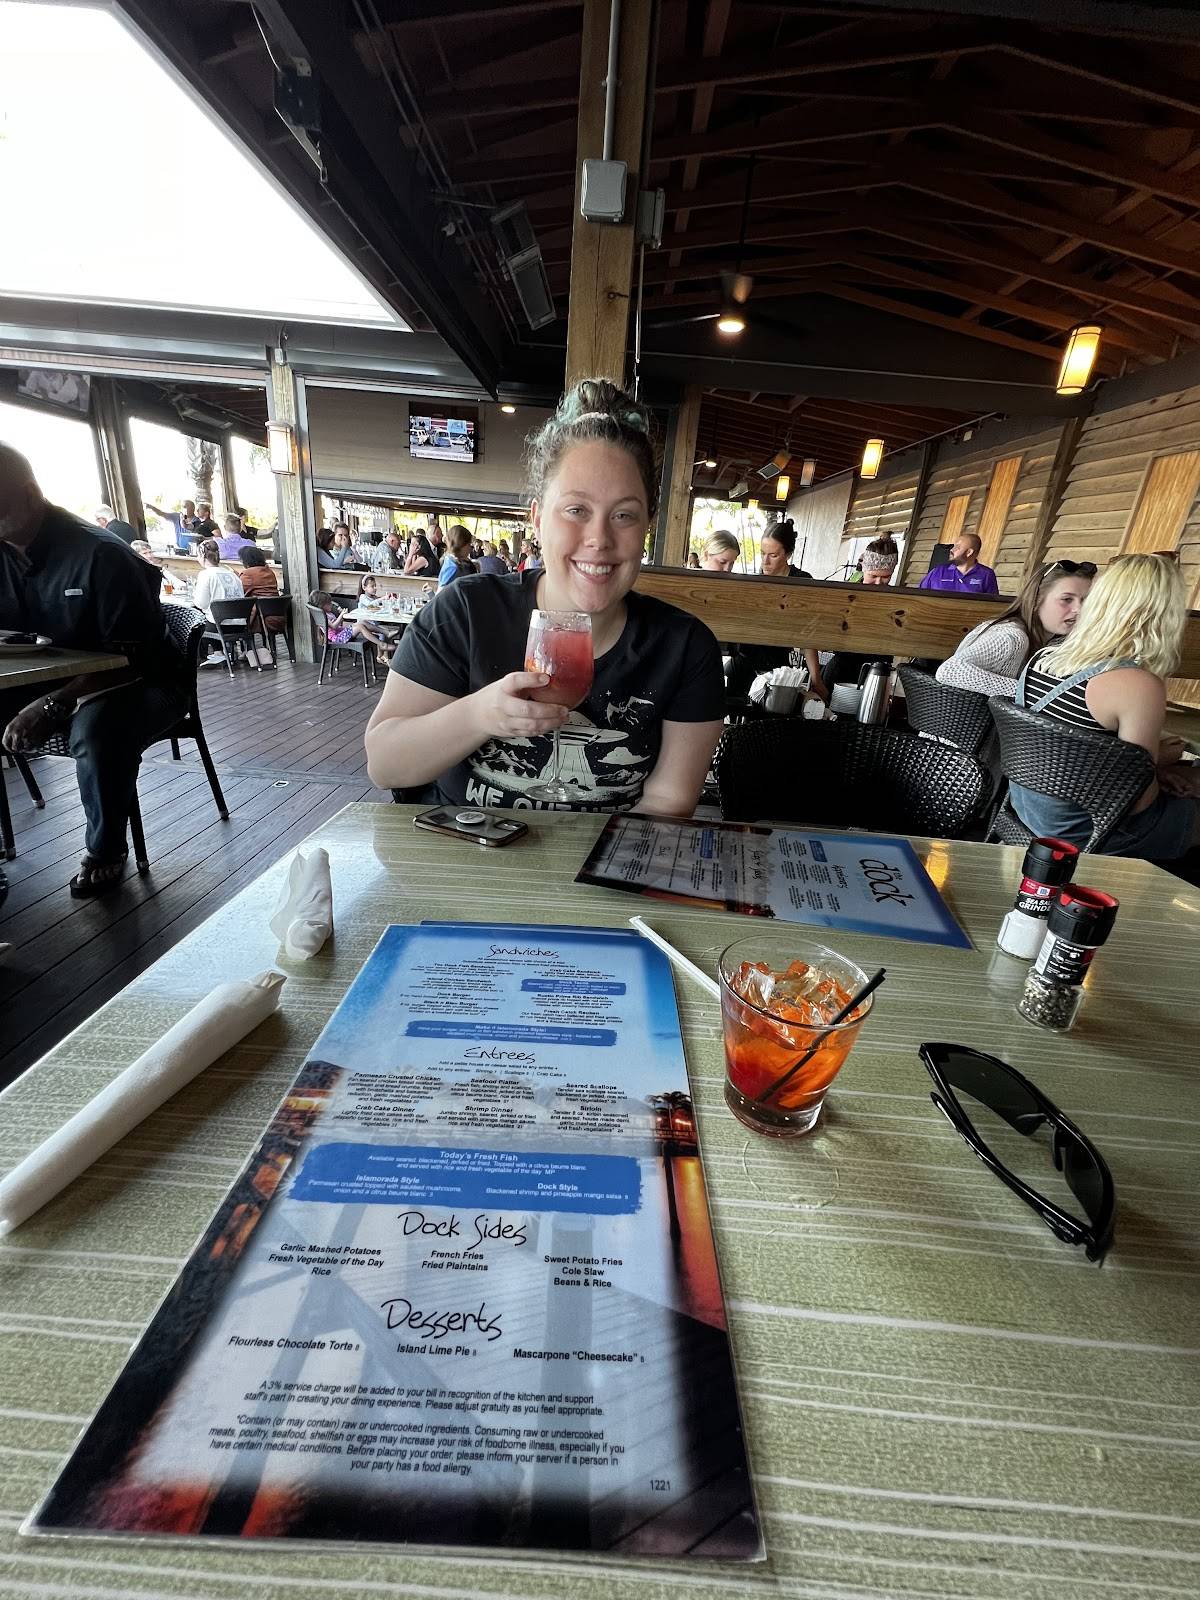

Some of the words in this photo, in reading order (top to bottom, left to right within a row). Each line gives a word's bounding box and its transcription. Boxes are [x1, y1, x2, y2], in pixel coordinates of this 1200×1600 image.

[859, 859, 915, 906] dock
[1026, 898, 1038, 906] SEA
[487, 944, 560, 958] Sandwiches
[464, 1046, 536, 1064] Entrees
[440, 1151, 471, 1160] Today's
[398, 1212, 460, 1238] Dock
[467, 1214, 527, 1250] Sides
[280, 1243, 305, 1251] Garlic
[308, 1244, 342, 1253] Mashed
[343, 1246, 380, 1255] Potatoes
[430, 1250, 460, 1258] French
[462, 1251, 483, 1259] Fries
[268, 1253, 293, 1261] Fresh
[297, 1255, 337, 1264] Vegetable
[367, 1258, 384, 1267] Day
[421, 1260, 444, 1268] Fried
[446, 1261, 487, 1270] Plaintains
[544, 1255, 569, 1263] Sweet
[572, 1256, 599, 1264] Potato
[601, 1257, 622, 1265] Fries
[310, 1266, 330, 1275] Rice
[562, 1266, 581, 1274] Cole
[584, 1267, 604, 1275] Slaw
[553, 1277, 580, 1285] Beans
[583, 1278, 589, 1286] &
[592, 1278, 611, 1287] Rice
[381, 1298, 502, 1341] Desserts
[228, 1336, 273, 1346] Flourless
[276, 1338, 325, 1349] Chocolate
[329, 1340, 352, 1350] Torte
[397, 1343, 426, 1353] Island
[428, 1345, 452, 1354] Lime
[454, 1345, 469, 1355] Pie
[513, 1349, 569, 1359] Mascarpone
[259, 1380, 266, 1389] A
[283, 1383, 312, 1391] service
[313, 1384, 341, 1394] charge
[343, 1384, 356, 1393] will
[357, 1384, 368, 1394] be
[369, 1386, 395, 1395] added
[396, 1386, 404, 1395] to
[405, 1389, 424, 1398] your
[425, 1388, 437, 1397] bill
[448, 1390, 490, 1400] recognition
[492, 1390, 501, 1400] of
[502, 1391, 515, 1400] the
[517, 1392, 545, 1401] kitchen
[547, 1394, 562, 1402] and
[564, 1395, 593, 1404] support
[268, 1393, 286, 1402] part
[285, 1392, 295, 1403] in
[296, 1394, 329, 1405] creating
[330, 1396, 349, 1406] your
[350, 1395, 375, 1407] dining
[425, 1399, 452, 1409] Please
[454, 1400, 478, 1410] adjust
[480, 1403, 510, 1413] gratuity
[524, 1405, 538, 1414] you
[540, 1404, 555, 1413] feel
[286, 1418, 304, 1428] may
[340, 1420, 357, 1429] raw
[358, 1421, 368, 1429] or
[369, 1422, 422, 1432] undercooked
[474, 1425, 520, 1438] Consuming
[522, 1429, 538, 1437] raw
[540, 1429, 548, 1437] or
[551, 1430, 603, 1439] undercooked
[310, 1430, 344, 1440] shellfish
[345, 1433, 356, 1441] or
[356, 1434, 377, 1445] eggs
[379, 1435, 398, 1445] may
[399, 1436, 434, 1445] increase
[437, 1438, 456, 1448] your
[457, 1436, 472, 1447] risk
[474, 1437, 483, 1447] of
[484, 1438, 526, 1449] foodborne
[559, 1442, 599, 1453] especially
[602, 1442, 607, 1452] if
[609, 1445, 624, 1454] you
[209, 1439, 231, 1449] have
[232, 1440, 262, 1450] certain
[263, 1441, 297, 1451] medical
[346, 1444, 374, 1455] Before
[376, 1447, 407, 1458] placing
[408, 1449, 428, 1459] your
[456, 1451, 484, 1460] please
[486, 1451, 512, 1461] inform
[515, 1454, 534, 1463] your
[535, 1454, 562, 1463] server
[564, 1453, 570, 1463] if
[571, 1455, 577, 1464] a
[579, 1456, 608, 1465] person
[610, 1455, 618, 1465] in
[350, 1460, 371, 1470] your
[371, 1460, 394, 1472] party
[395, 1461, 411, 1471] has
[413, 1462, 419, 1471] a
[421, 1461, 441, 1472] food
[650, 1480, 670, 1491] 1221
